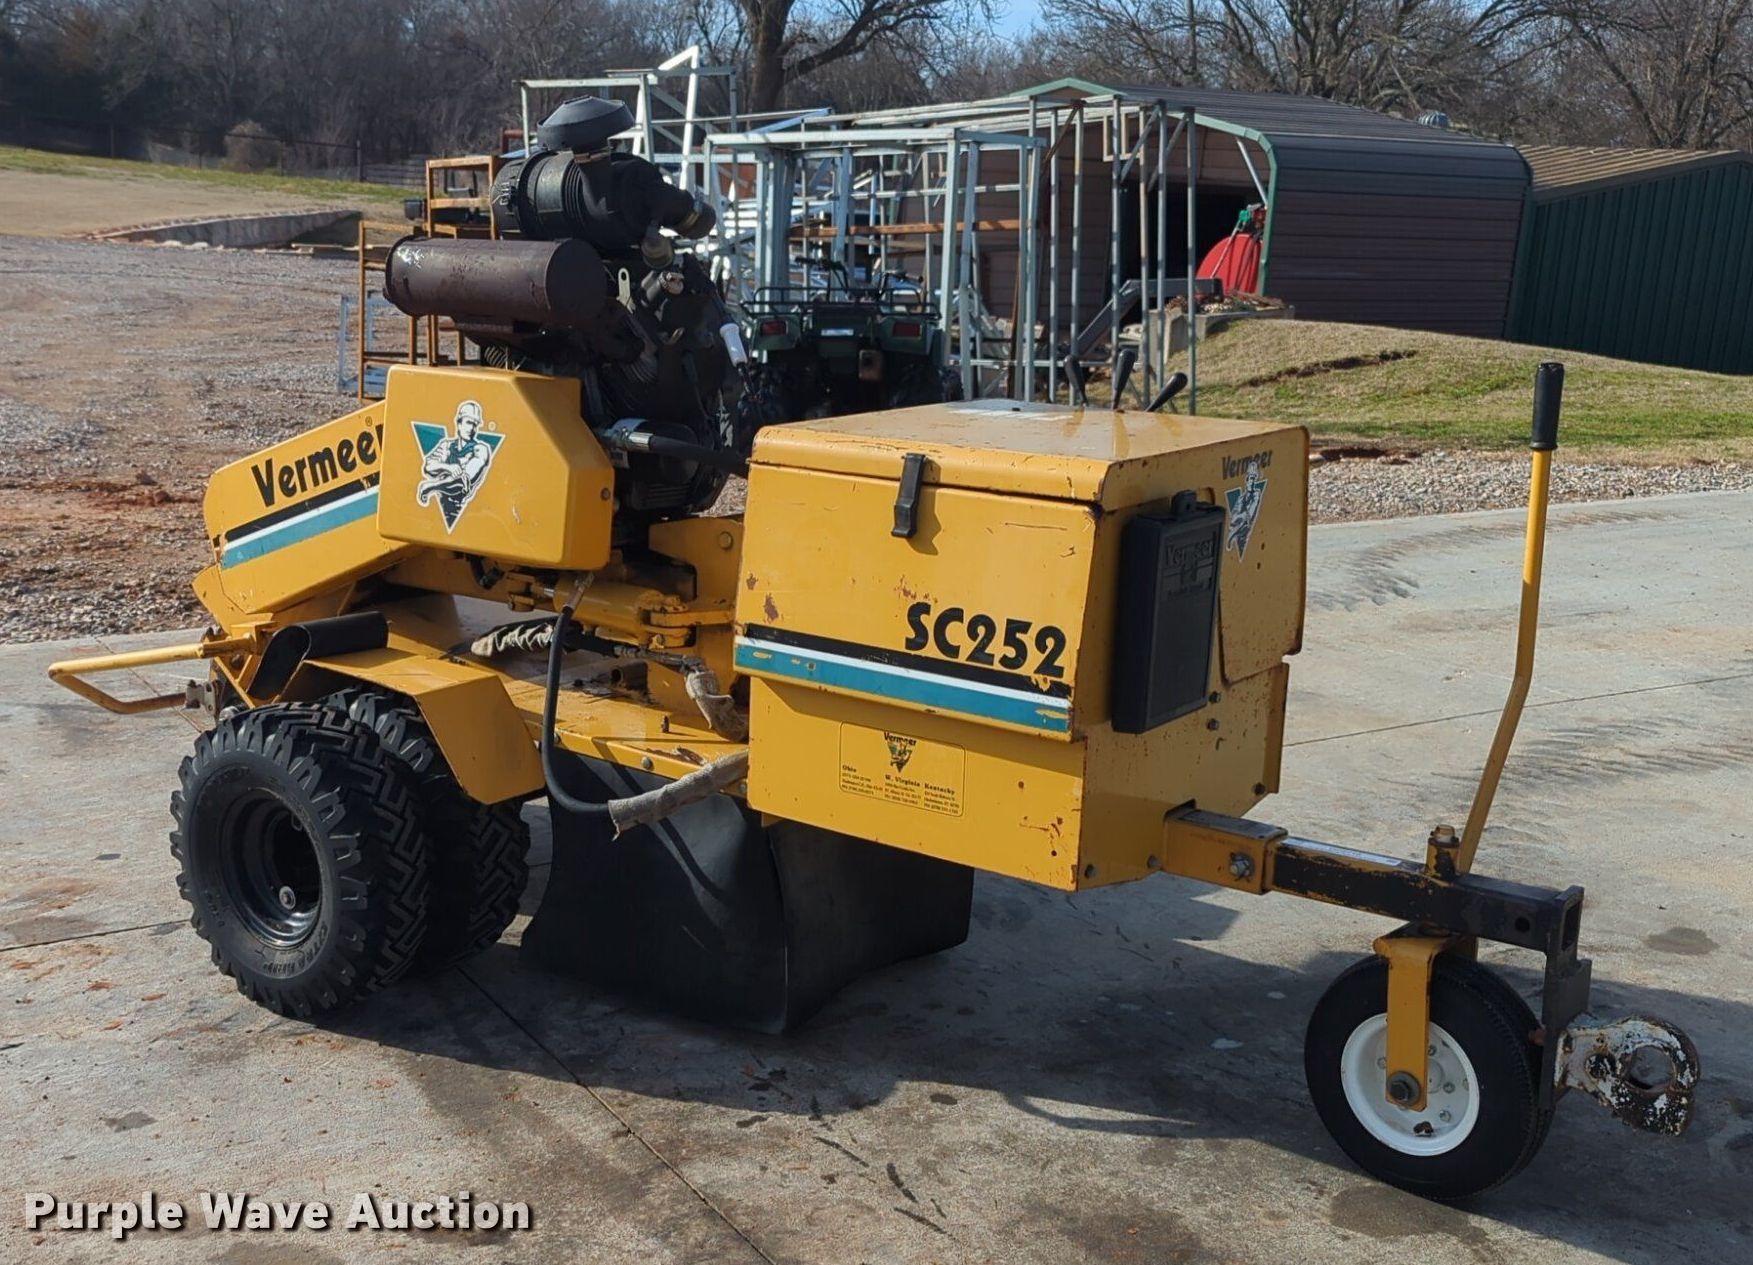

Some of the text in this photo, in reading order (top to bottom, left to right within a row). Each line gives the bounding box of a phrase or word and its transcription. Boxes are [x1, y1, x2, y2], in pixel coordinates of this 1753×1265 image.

[905, 601, 1066, 679] SC252
[842, 764, 857, 773] Ohio
[895, 776, 921, 787] Virginia
[924, 782, 956, 796] Kentucky
